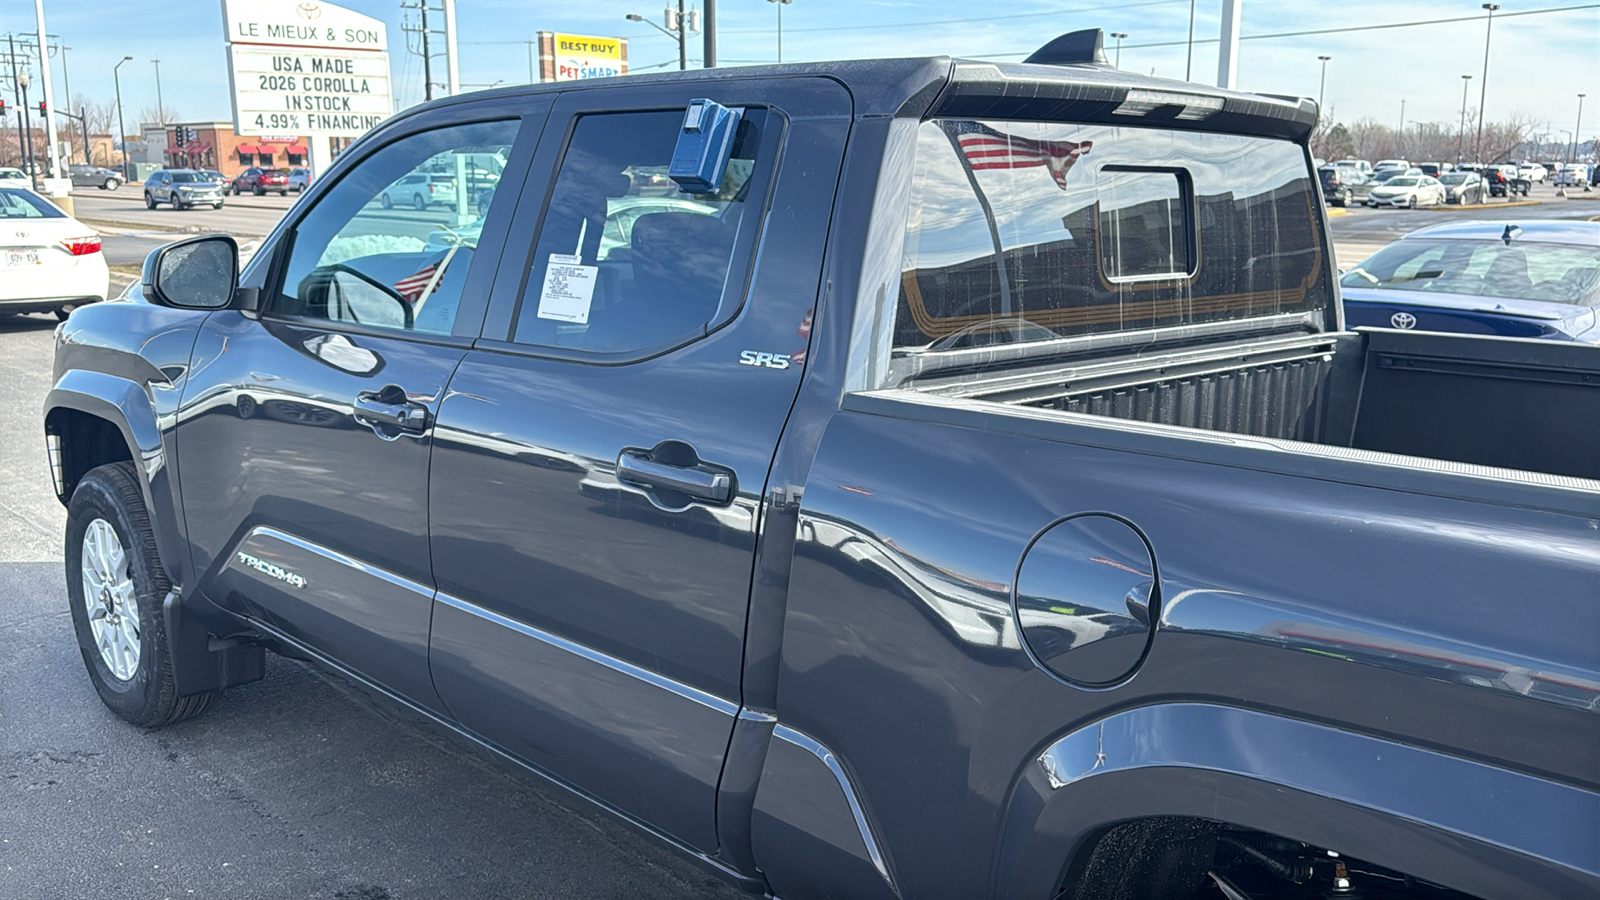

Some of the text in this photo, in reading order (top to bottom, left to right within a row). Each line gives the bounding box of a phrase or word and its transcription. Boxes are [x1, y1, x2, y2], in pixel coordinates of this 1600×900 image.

[239, 22, 379, 44] LE MIEUX & SON
[560, 41, 616, 54] BEST BUY
[272, 55, 354, 74] USA MADE
[259, 75, 370, 94] 2026 COROLLA
[255, 113, 382, 130] 4.99% FINANCING
[739, 350, 791, 370] SR5
[237, 551, 308, 589] TACOMA
